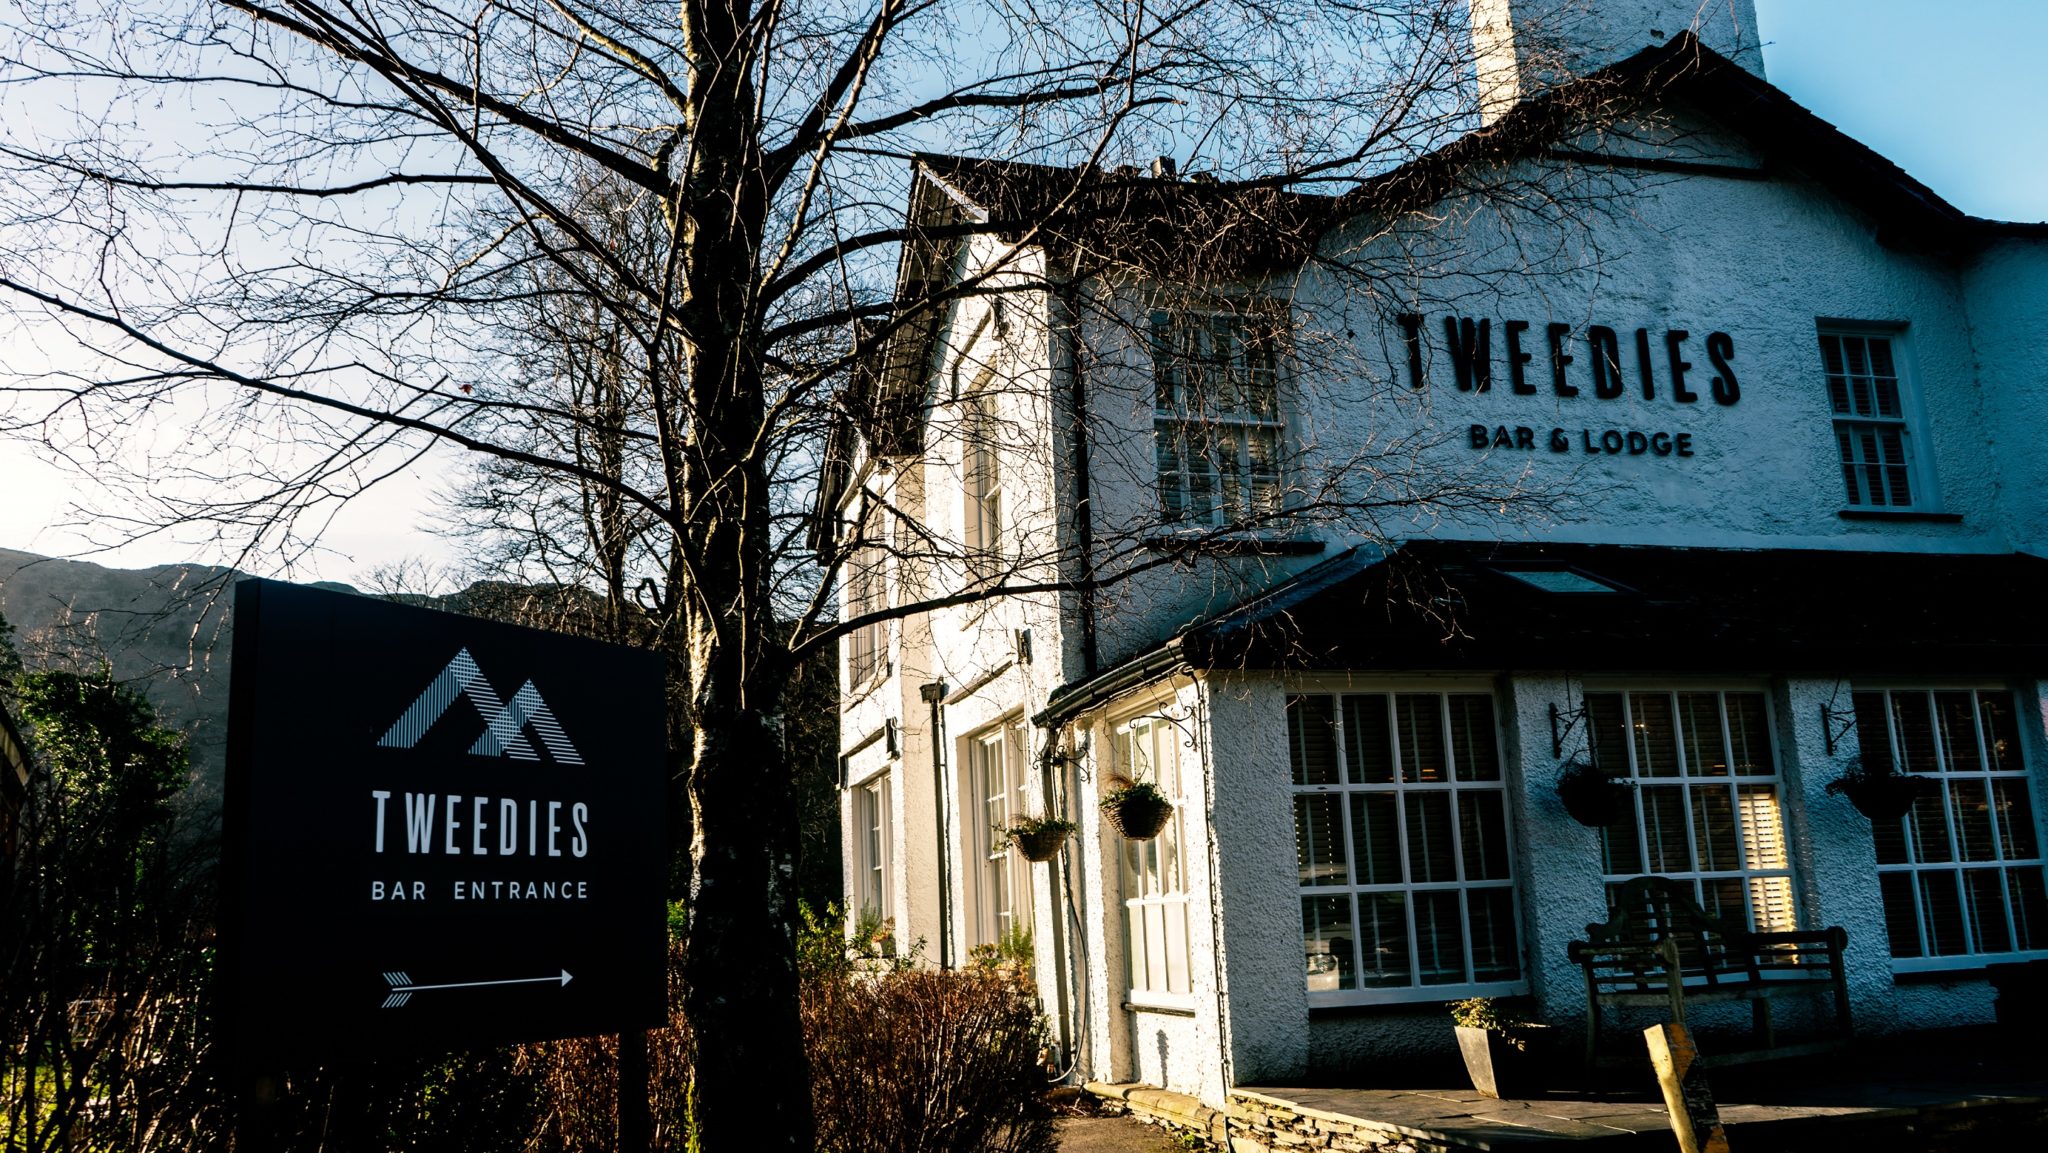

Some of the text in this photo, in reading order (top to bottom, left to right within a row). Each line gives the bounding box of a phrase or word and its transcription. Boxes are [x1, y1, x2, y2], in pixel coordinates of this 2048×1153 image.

[1397, 312, 1741, 406] TWEEDIES
[1470, 424, 1694, 457] BAR & LODGE
[372, 790, 588, 858] TWEEDIES
[372, 881, 588, 900] BAR ENTRANCE
